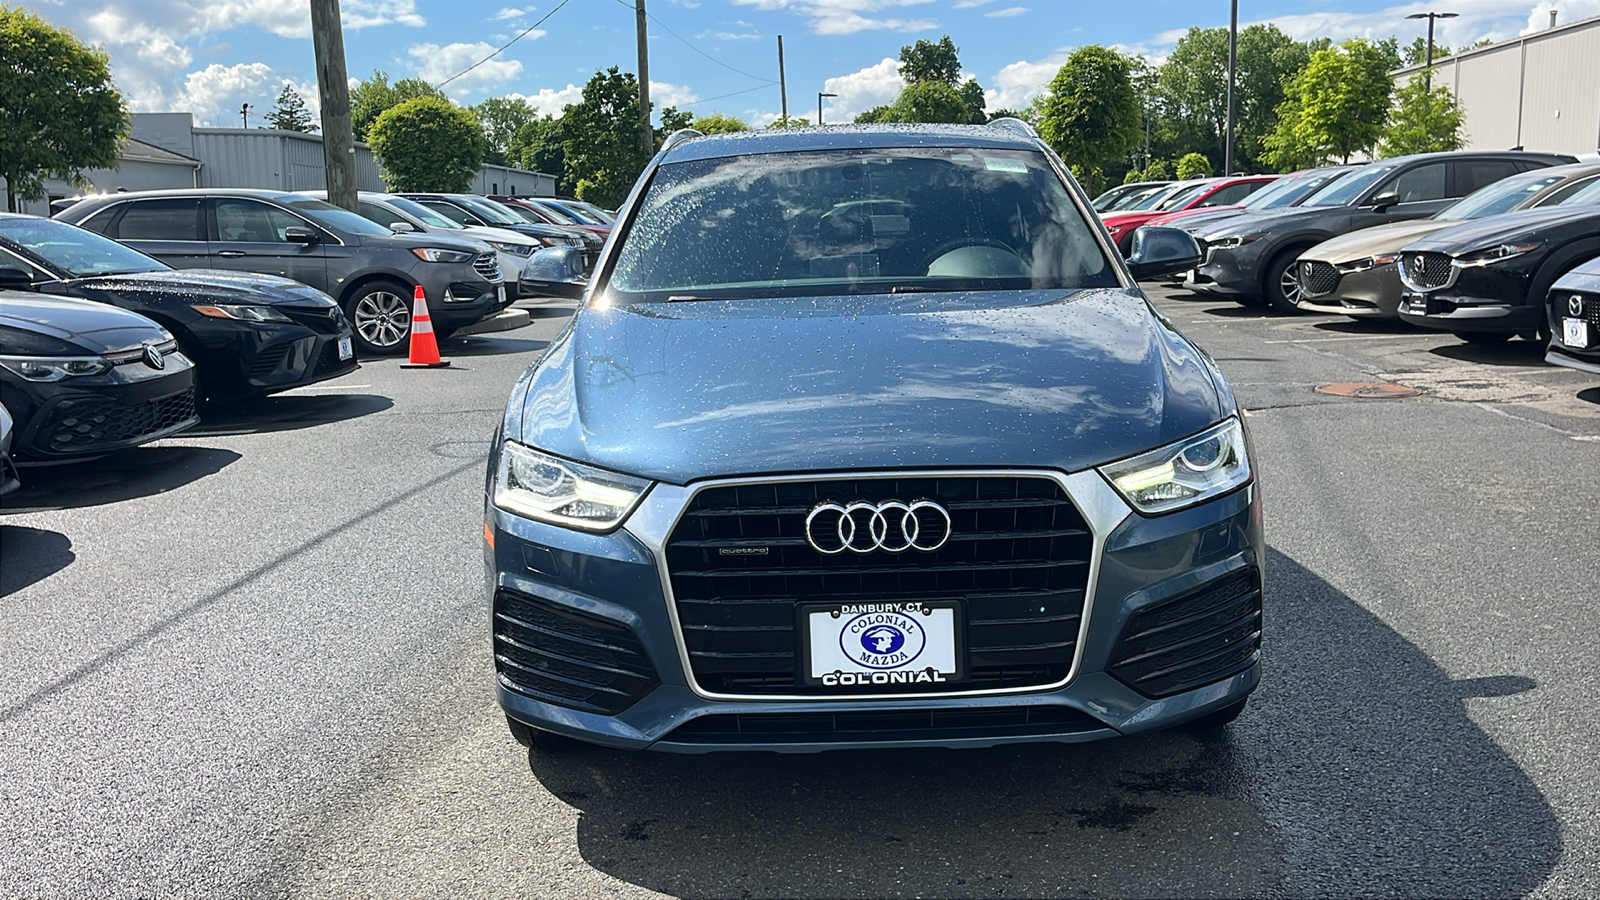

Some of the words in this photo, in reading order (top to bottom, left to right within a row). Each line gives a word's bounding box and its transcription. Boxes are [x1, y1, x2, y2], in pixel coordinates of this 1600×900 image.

[841, 603, 902, 614] DANBURY,
[905, 602, 923, 612] CT
[851, 615, 915, 635] COLONIAL
[859, 651, 909, 666] MAZDA
[822, 671, 946, 686] COLONIAL
